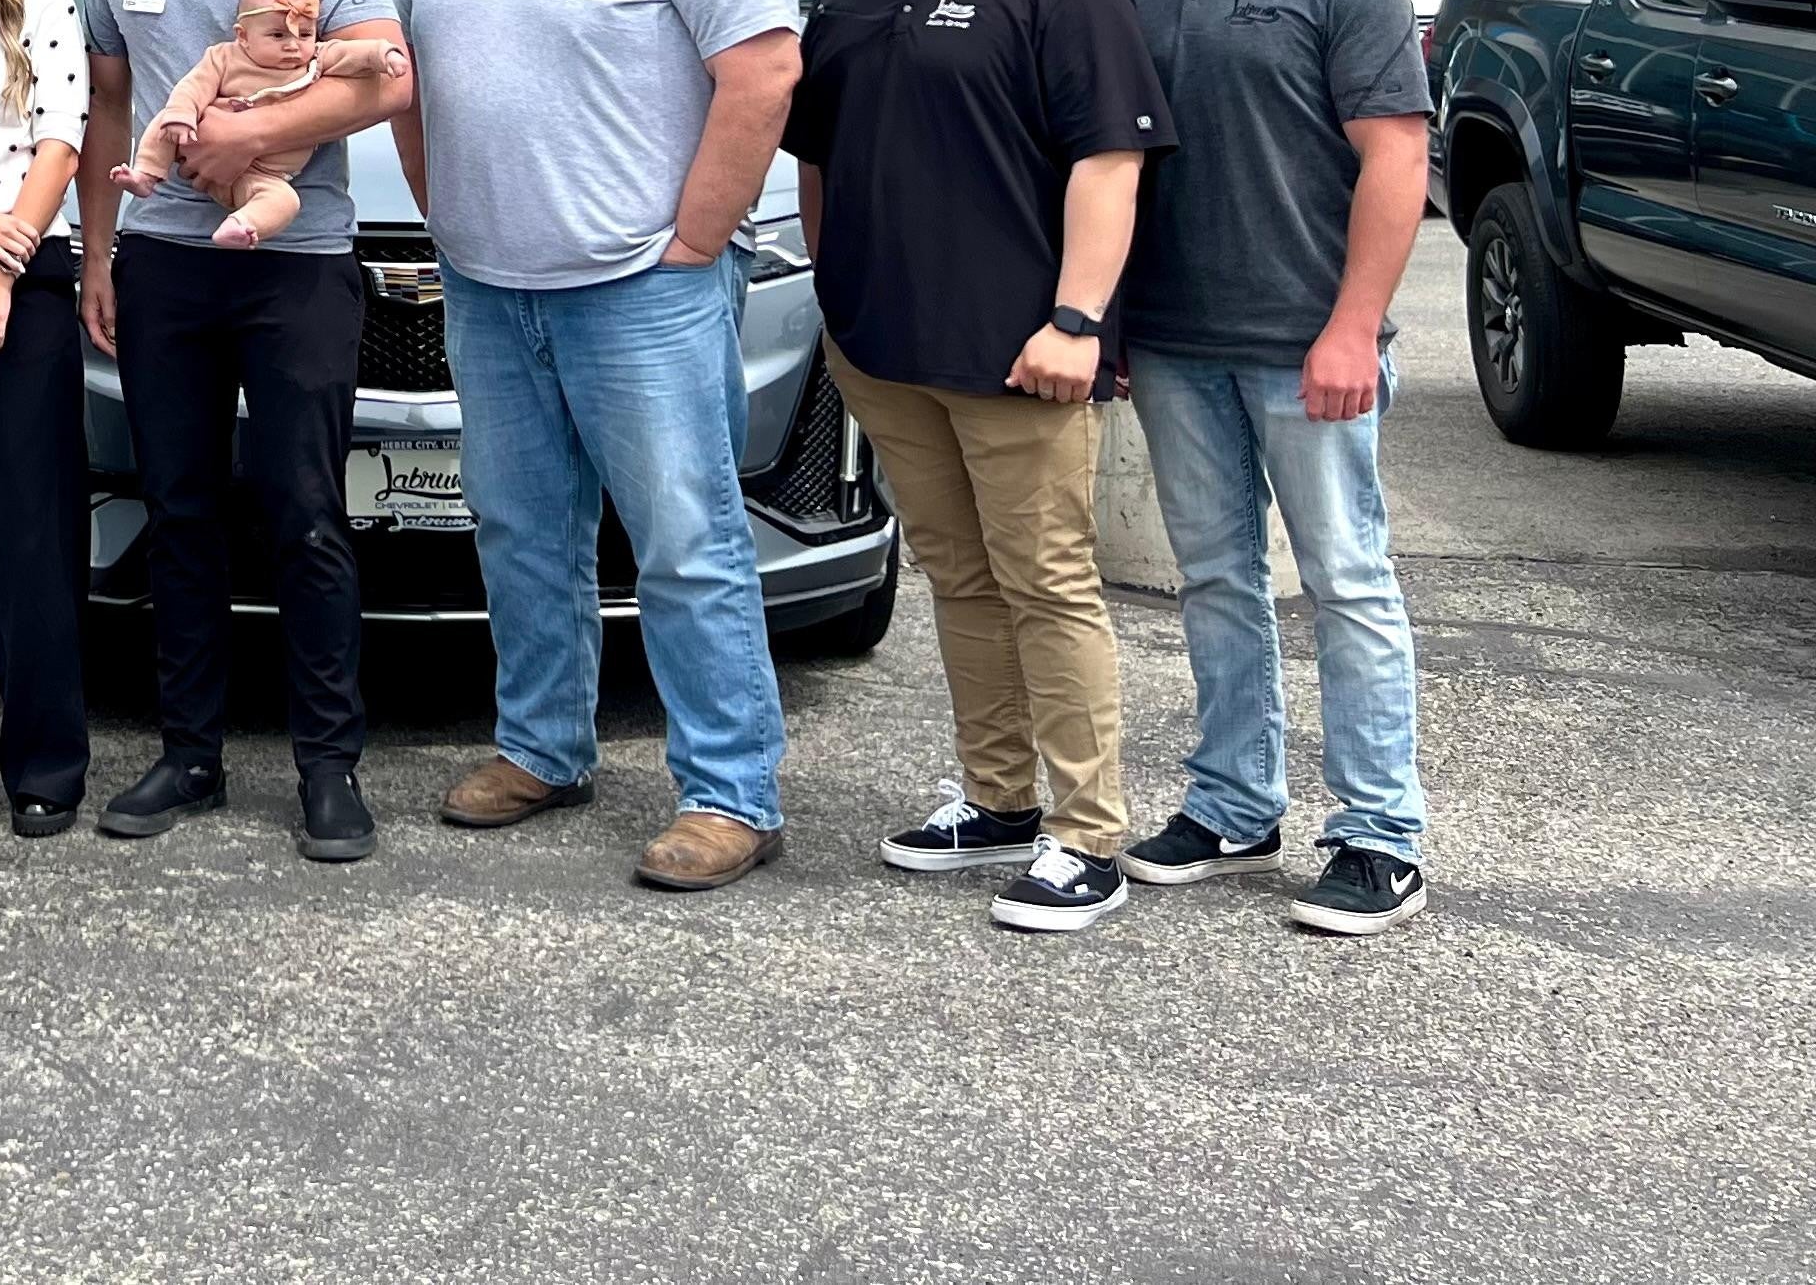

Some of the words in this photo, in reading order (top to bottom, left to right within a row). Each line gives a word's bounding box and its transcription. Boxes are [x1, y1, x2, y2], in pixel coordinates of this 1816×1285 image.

[380, 441, 413, 450] HEBER
[442, 441, 463, 450] UTA
[388, 511, 477, 532] Labrum
